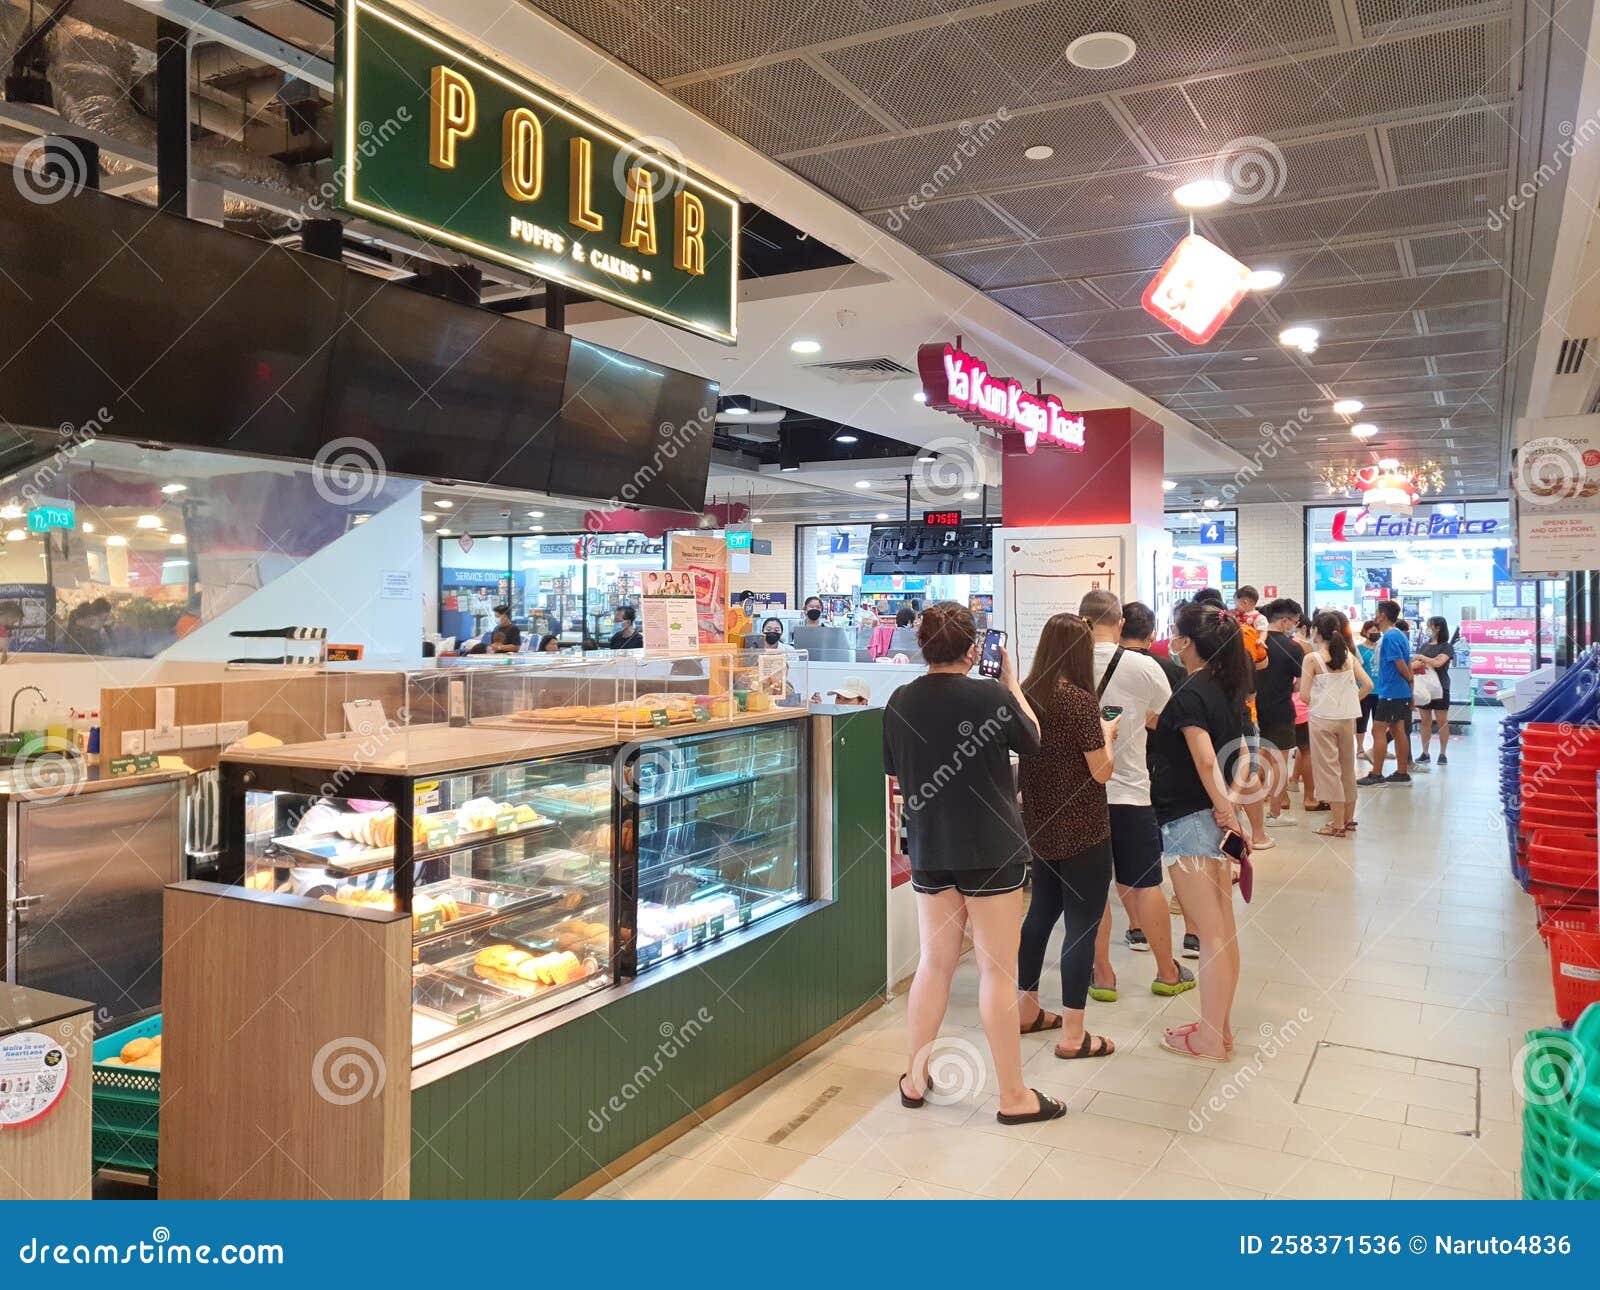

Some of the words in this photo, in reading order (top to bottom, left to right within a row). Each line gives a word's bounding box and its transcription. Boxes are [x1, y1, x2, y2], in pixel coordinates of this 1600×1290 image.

[429, 65, 705, 275] POLAR
[510, 216, 565, 253] PUFFS
[572, 241, 586, 262] &
[944, 354, 969, 400] Ya
[969, 367, 1007, 417] Kun
[1206, 525, 1219, 540] 4
[1375, 513, 1498, 537] FairPrice
[731, 536, 747, 546] EXIT
[836, 537, 843, 549] 7
[455, 571, 483, 582] SERVICE
